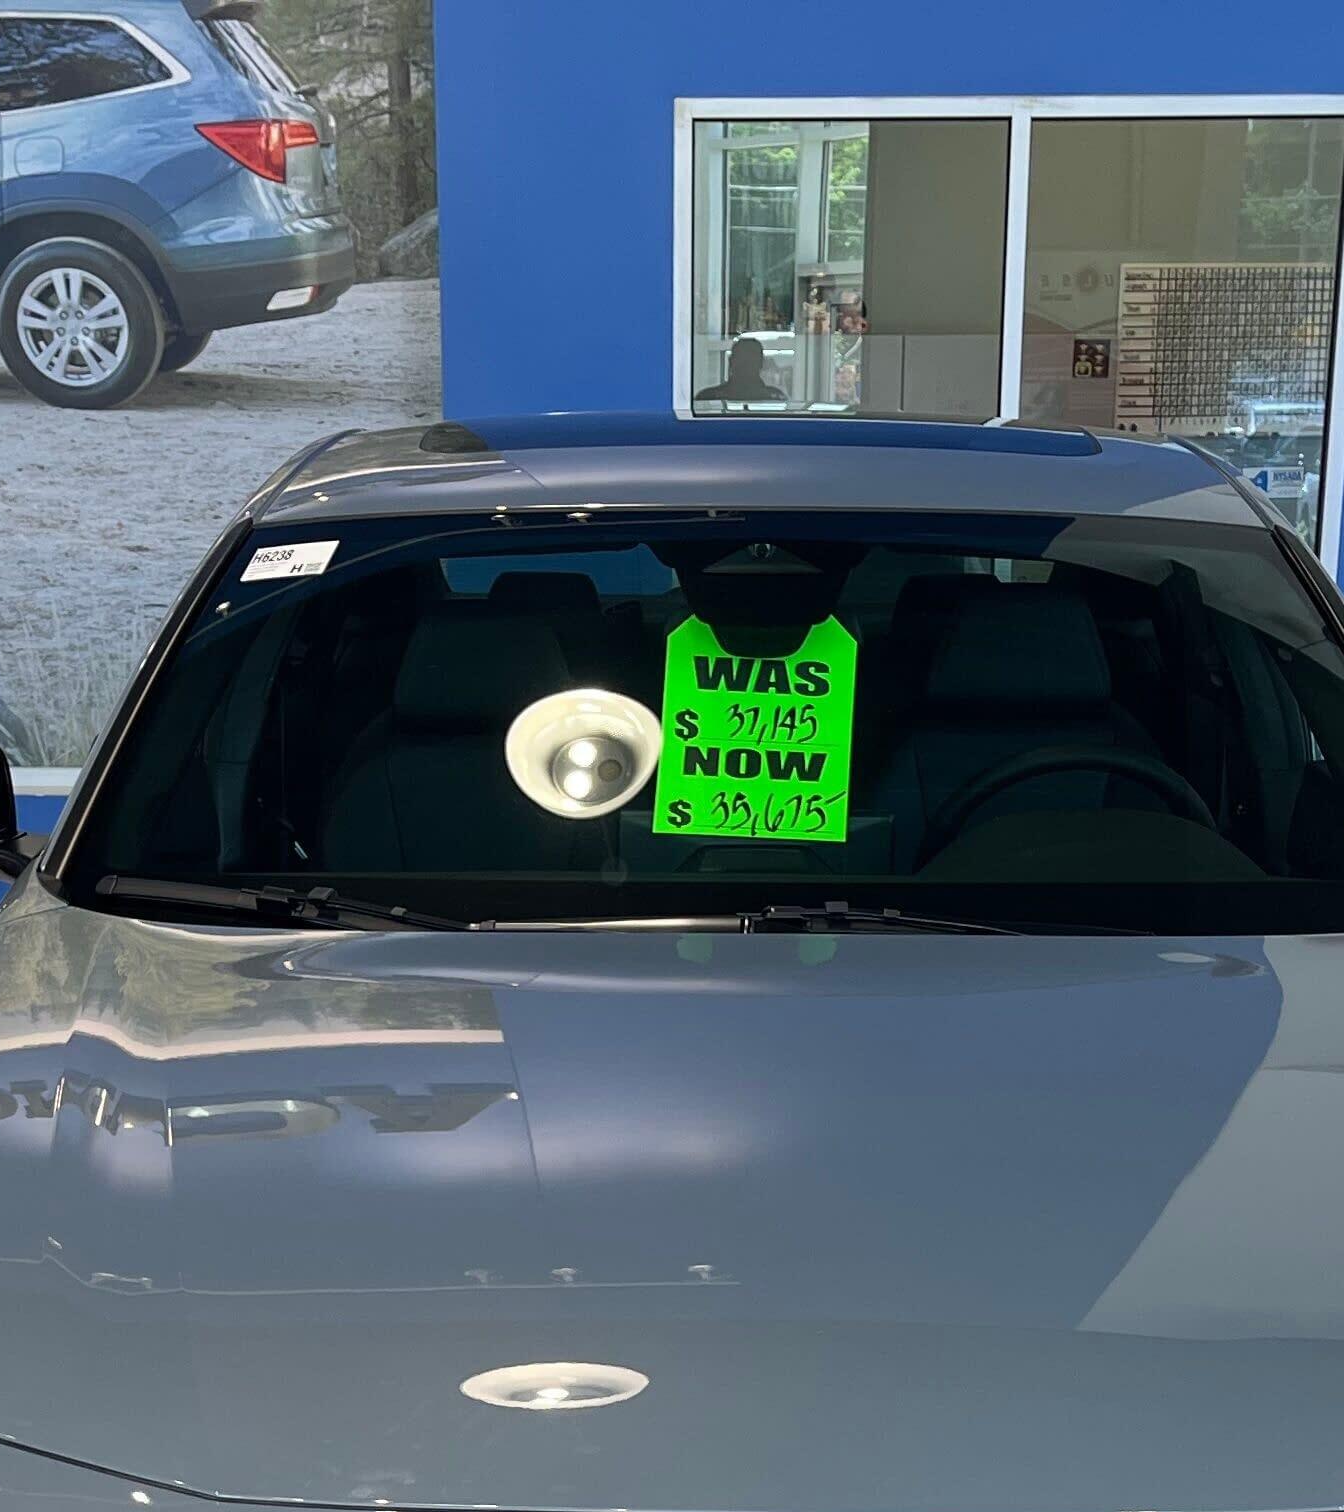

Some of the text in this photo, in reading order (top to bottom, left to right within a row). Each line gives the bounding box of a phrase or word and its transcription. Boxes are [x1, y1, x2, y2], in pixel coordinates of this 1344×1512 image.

[251, 549, 295, 565] H6238
[693, 655, 831, 698] WAS
[674, 703, 818, 746] $ 37,145
[682, 745, 828, 784] NOW
[666, 799, 693, 829] $
